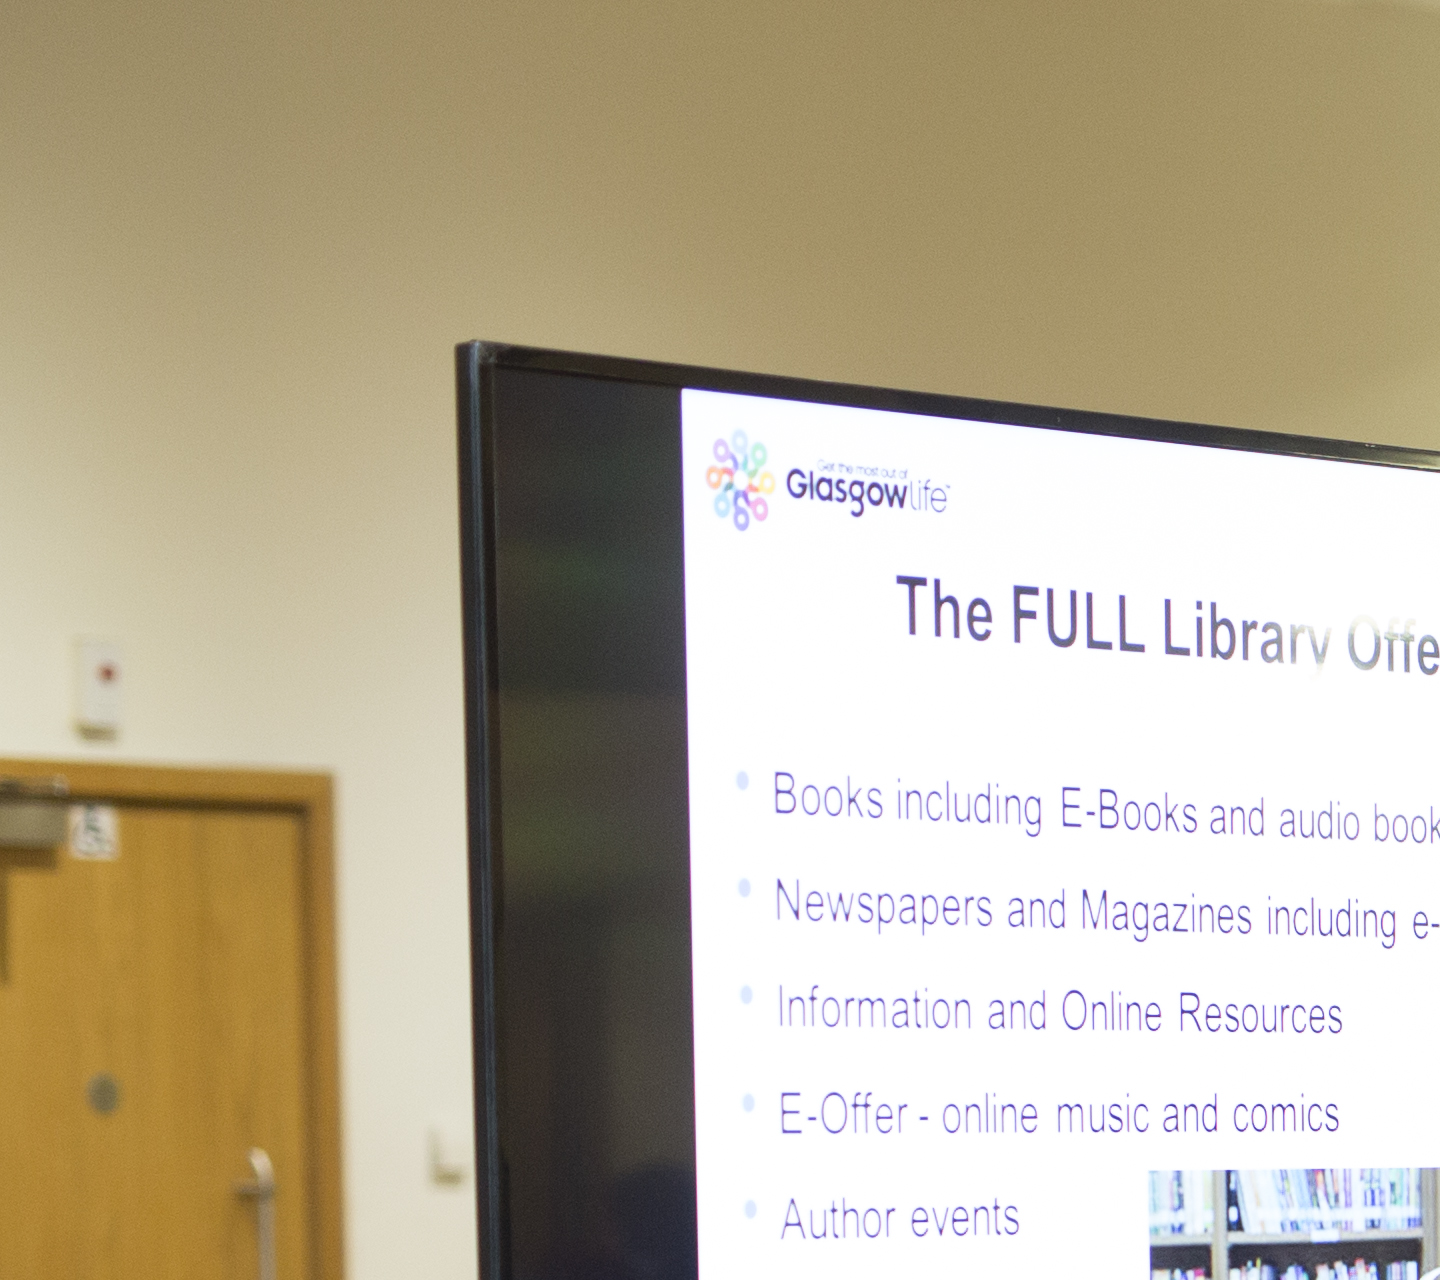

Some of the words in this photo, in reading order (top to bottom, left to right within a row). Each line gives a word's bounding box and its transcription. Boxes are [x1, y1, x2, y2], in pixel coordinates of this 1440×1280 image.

[895, 574, 993, 642] The
[1012, 584, 1146, 653] FULL
[1164, 598, 1332, 680] Library
[774, 771, 883, 819] Books
[898, 778, 1042, 838] including
[1062, 786, 1198, 834] E-Books
[1210, 797, 1264, 837] and
[1279, 801, 1360, 841] audio
[776, 878, 993, 935] Newspapers
[1008, 889, 1066, 929] and
[1082, 889, 1252, 943] Magazines
[1268, 896, 1396, 950] including
[779, 984, 971, 1029] Information
[988, 990, 1046, 1031] and
[1062, 989, 1162, 1032] Online
[1180, 991, 1343, 1034] Resources
[780, 1091, 908, 1135] E-Offer
[942, 1093, 1038, 1134] online
[1057, 1093, 1149, 1133] music
[1162, 1093, 1218, 1133] and
[1233, 1093, 1340, 1133] comics
[781, 1198, 896, 1240] Author
[911, 1198, 1020, 1238] events
